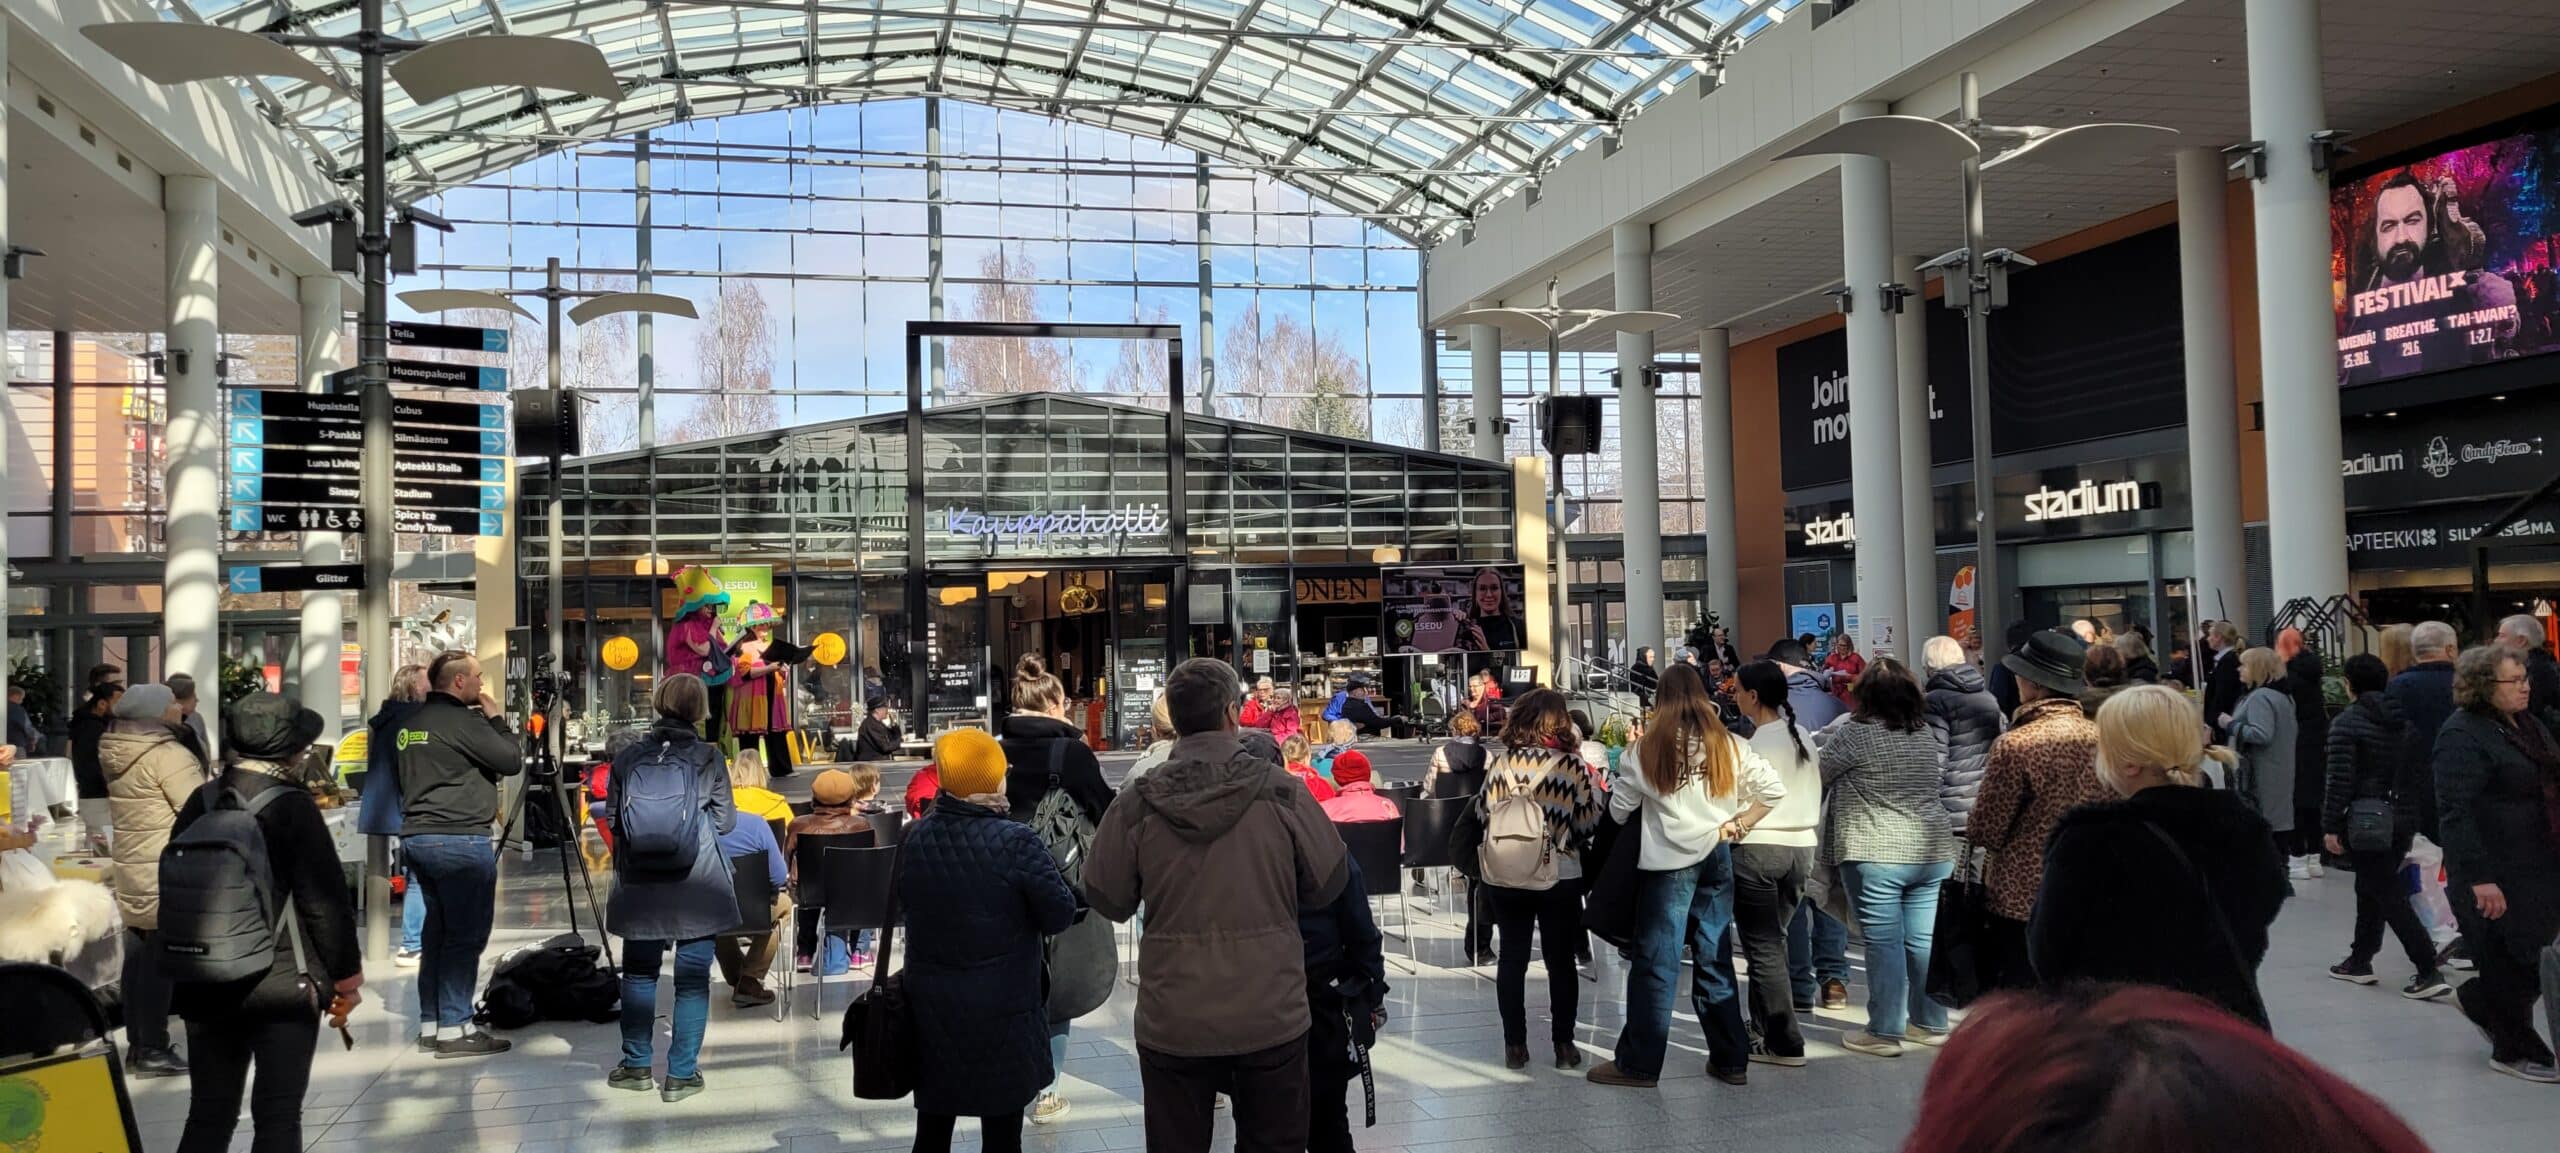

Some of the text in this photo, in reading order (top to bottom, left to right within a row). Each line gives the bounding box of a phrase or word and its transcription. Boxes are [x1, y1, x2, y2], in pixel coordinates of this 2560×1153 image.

[2448, 304, 2517, 328] TAI-WAN?
[393, 328, 415, 339] Telia
[2385, 318, 2439, 341] BREATHE.
[392, 366, 466, 381] Huonepakopeli
[394, 405, 422, 415] Cubus
[319, 430, 361, 440] S-Pankki
[394, 433, 448, 445] Silmäasema
[307, 459, 360, 470] Luna Living
[394, 461, 462, 473] Apteekki Stella
[2341, 453, 2403, 476] adium
[328, 486, 360, 499] Sinsay
[394, 488, 432, 499] Stadium
[2025, 479, 2140, 522] stadium
[266, 514, 287, 523] WC
[394, 510, 437, 521] Spice Ice
[394, 522, 452, 533] Candy Town
[949, 503, 1169, 545] Kauppahalli
[2448, 519, 2555, 542] SILMSEMA
[2344, 529, 2420, 551] APTEEKKI
[315, 574, 349, 583] Glitter
[724, 580, 758, 589] ESEDU
[1296, 578, 1368, 600] ONEN
[1415, 621, 1443, 631] ESEDU
[506, 657, 527, 679] LAND
[506, 684, 516, 706] OF
[1359, 1043, 1374, 1118] marimekko
